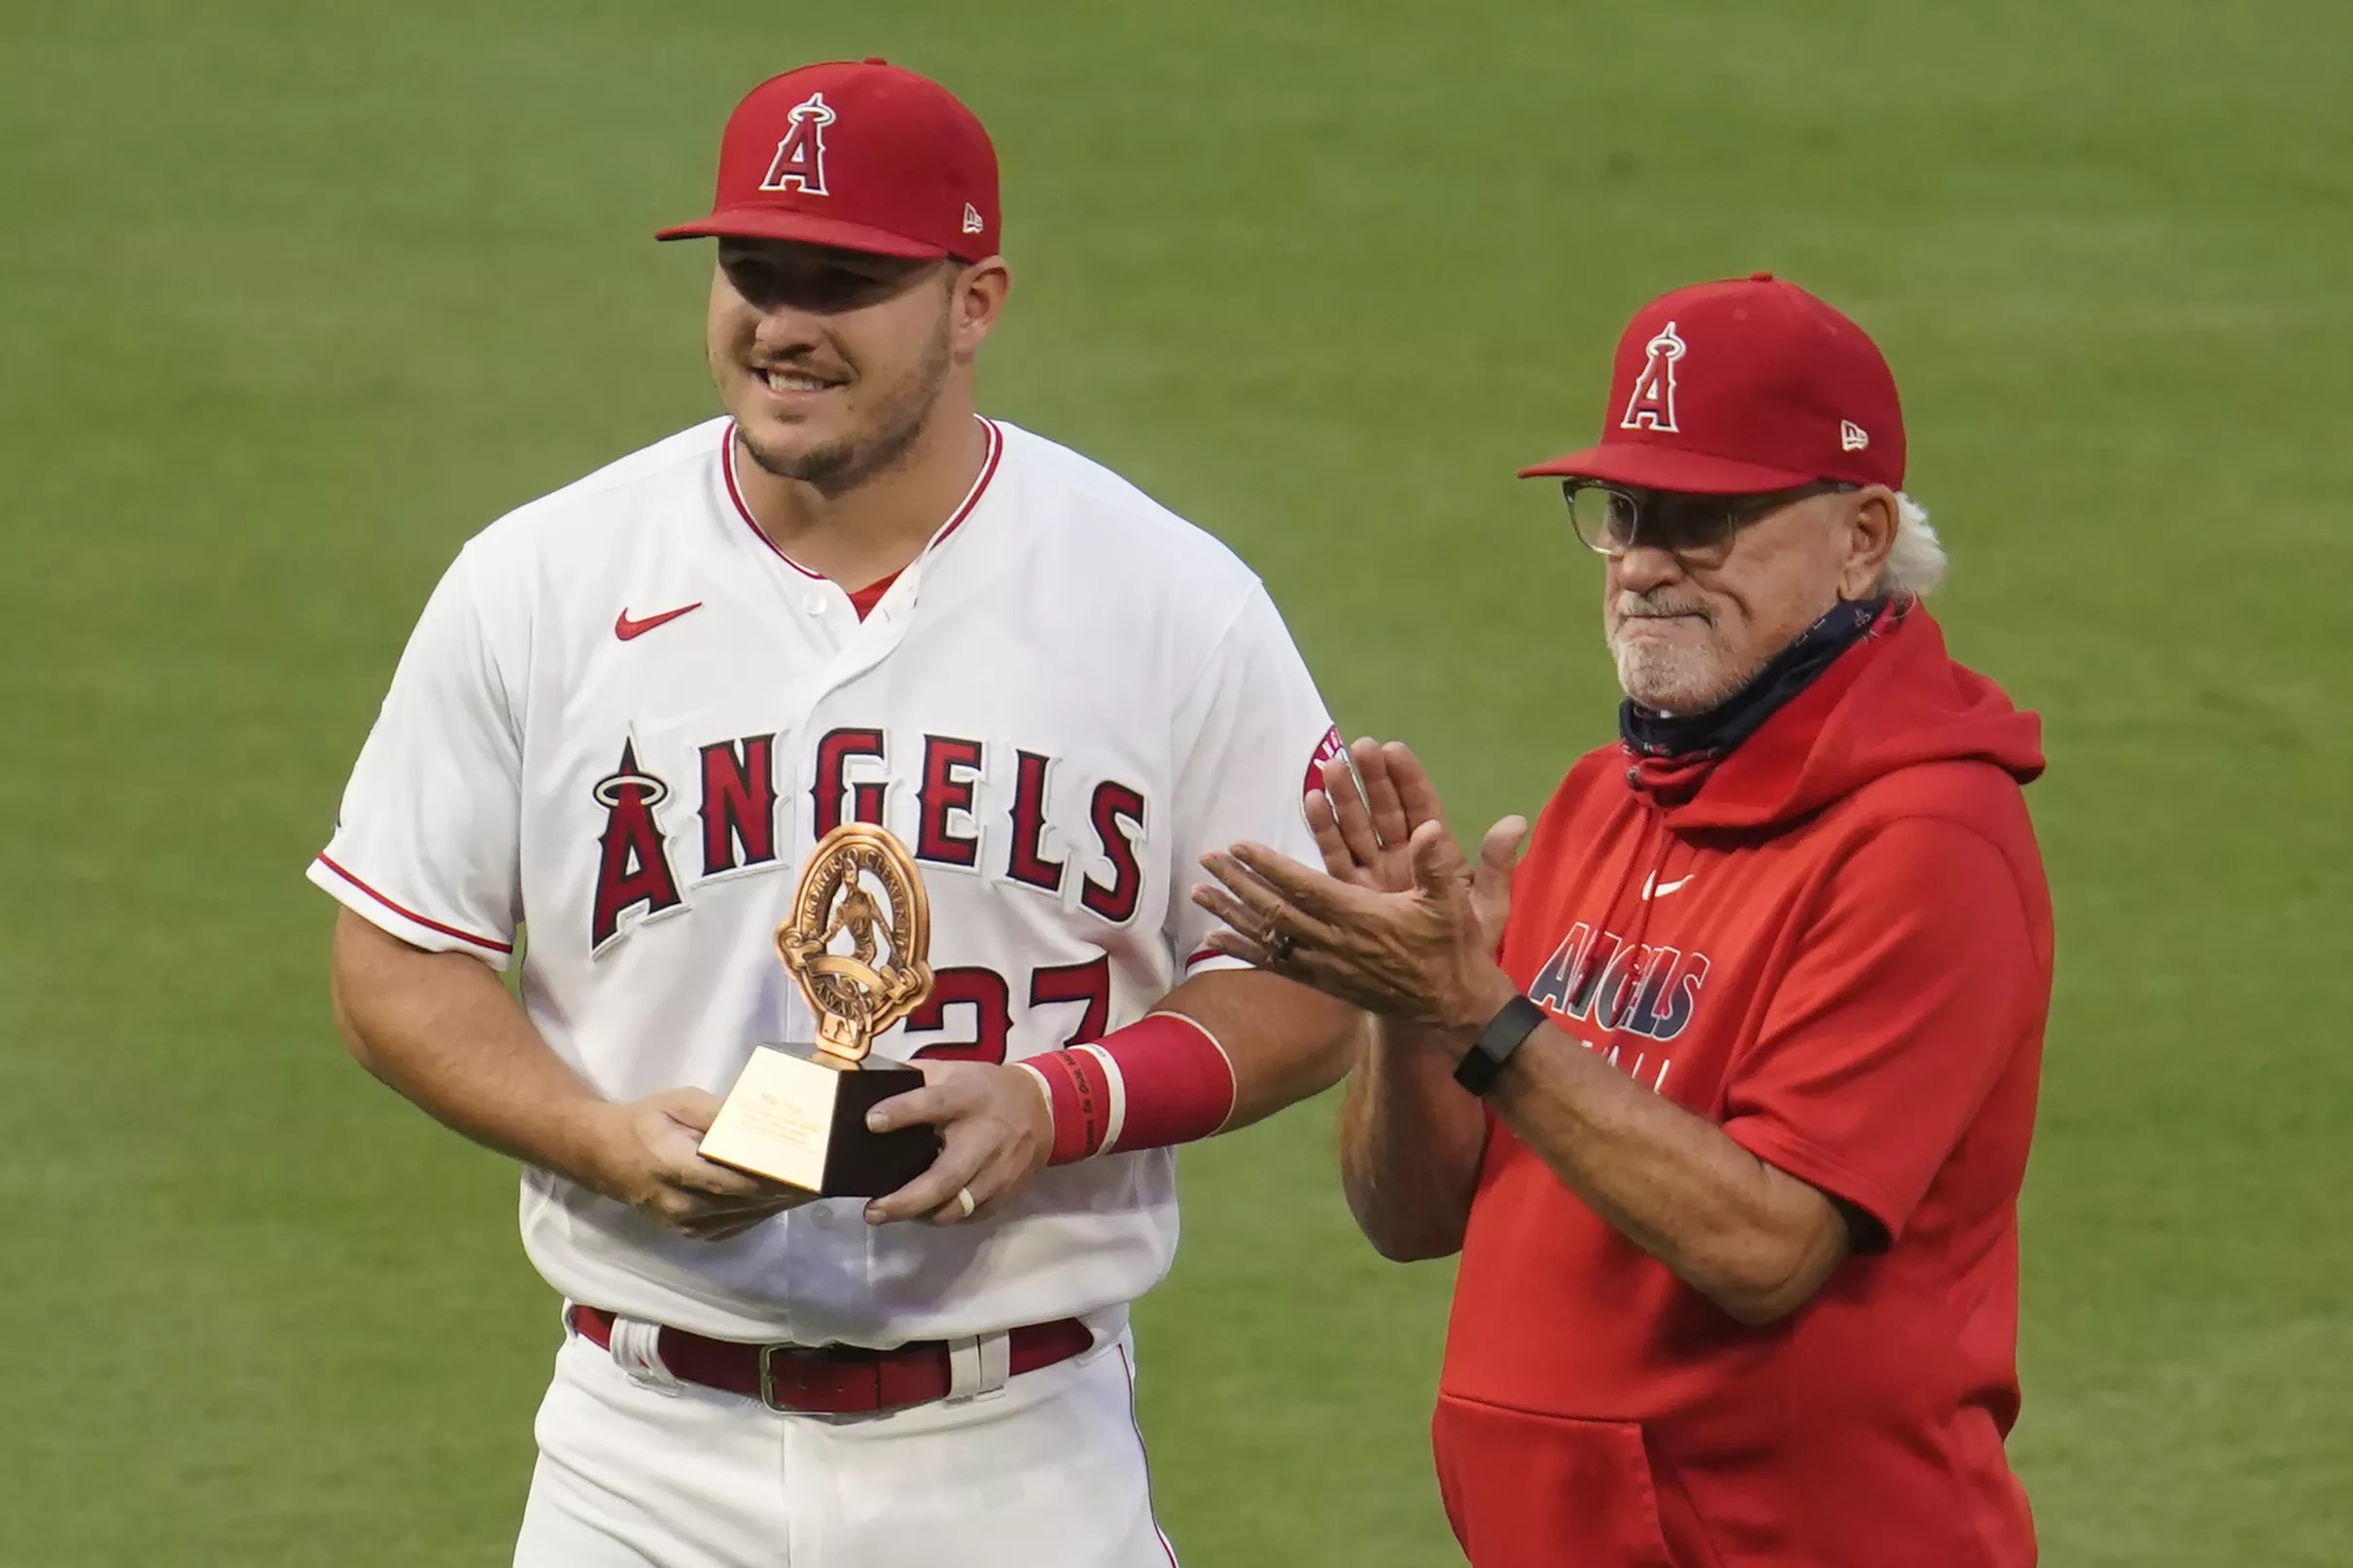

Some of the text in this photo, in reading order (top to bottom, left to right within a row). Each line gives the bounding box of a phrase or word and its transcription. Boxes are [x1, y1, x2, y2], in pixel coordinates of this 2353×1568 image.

[759, 92, 836, 196] A
[1620, 321, 1687, 433] A
[590, 725, 1146, 960] ANGELS
[903, 953, 1111, 1067] 27
